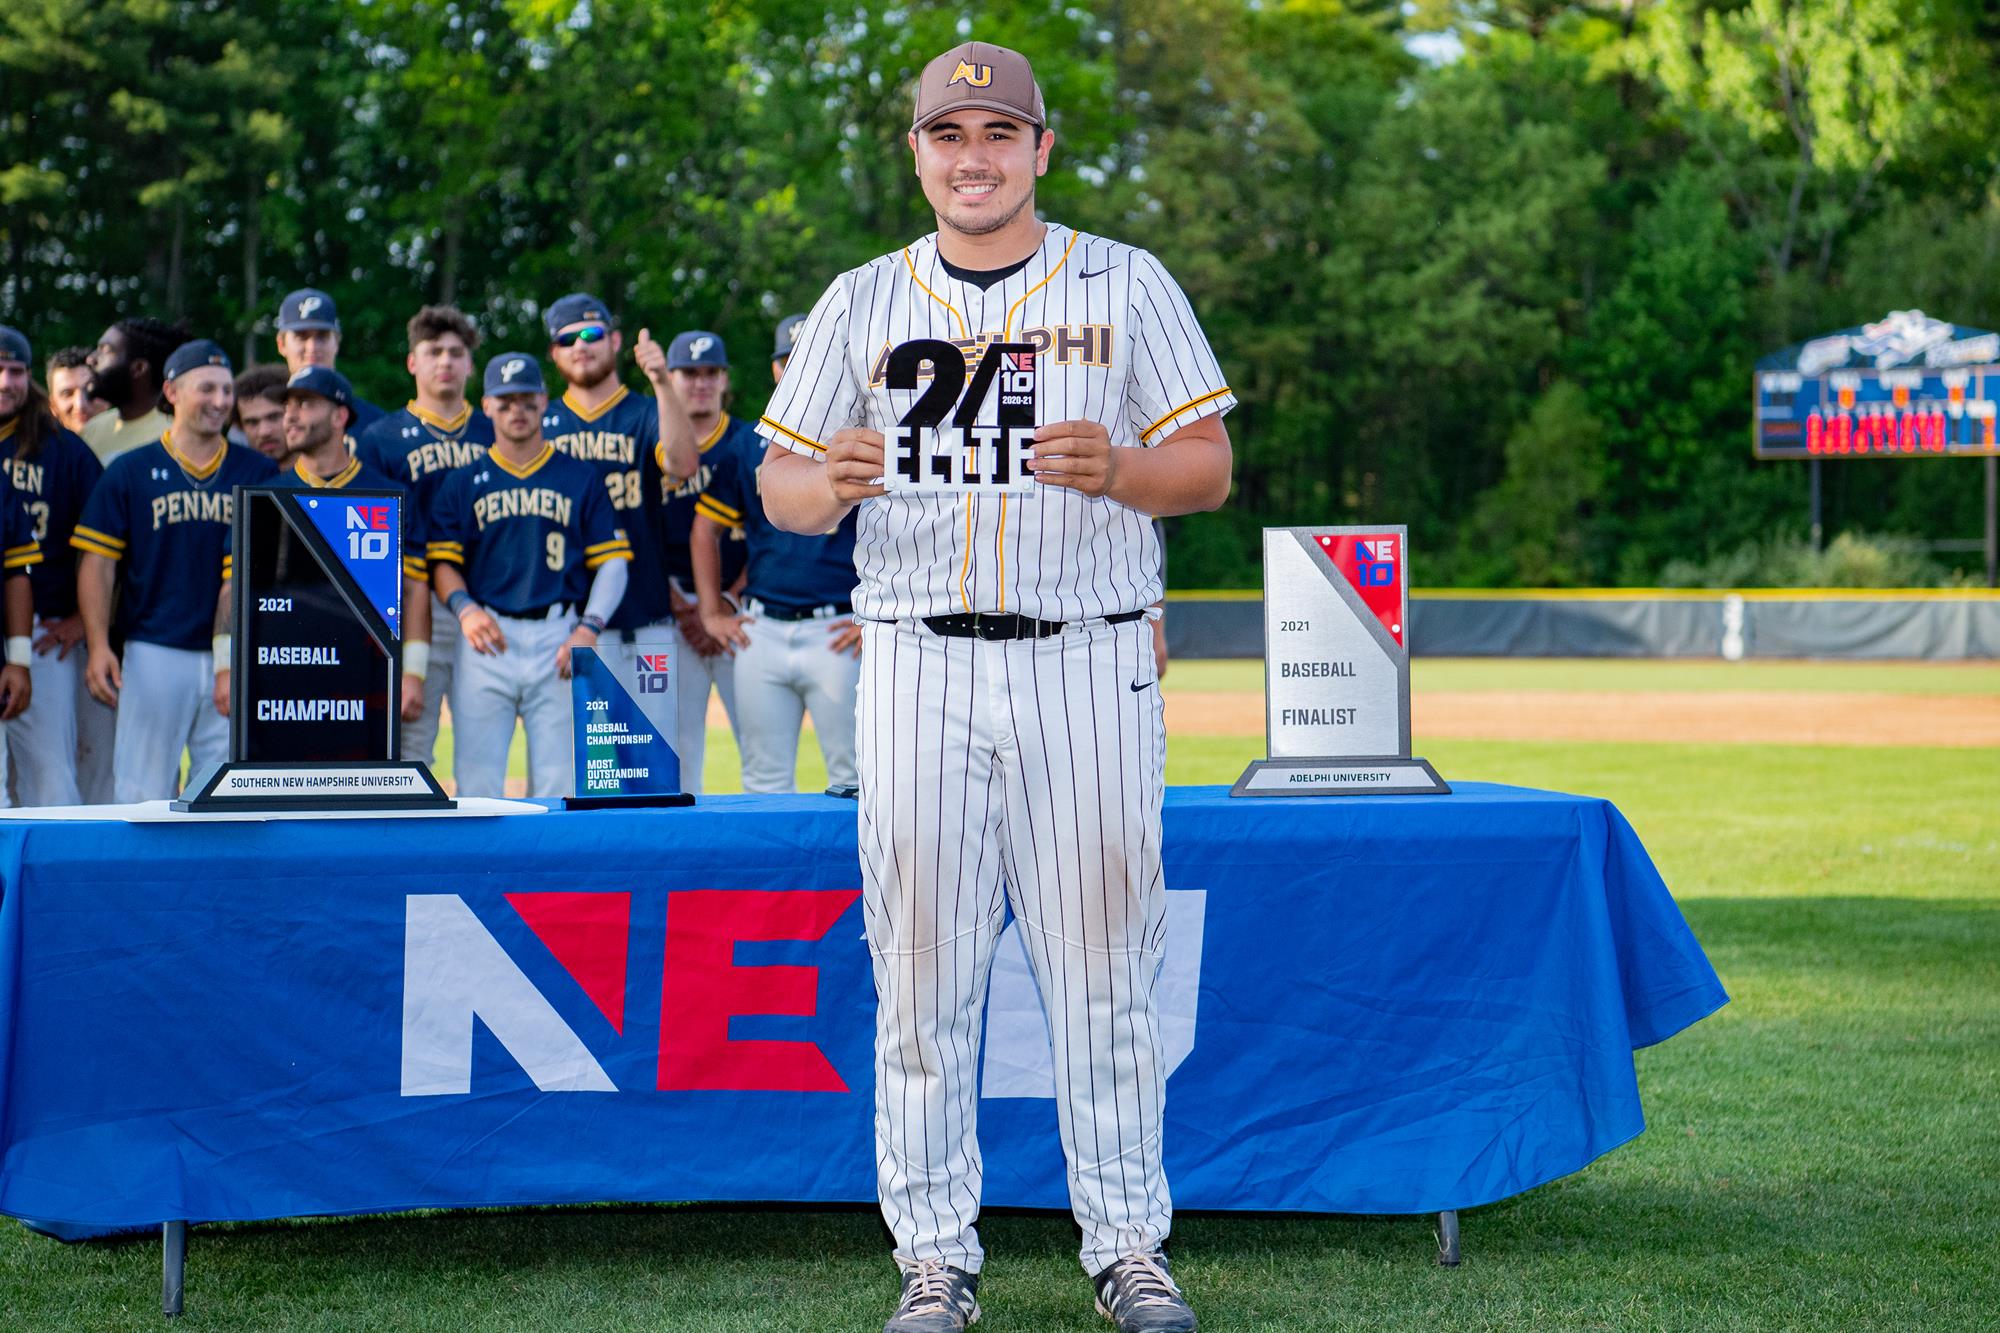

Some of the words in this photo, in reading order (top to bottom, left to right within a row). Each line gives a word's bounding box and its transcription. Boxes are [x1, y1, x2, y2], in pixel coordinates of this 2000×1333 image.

[946, 58, 993, 88] AU
[1000, 351, 1034, 371] NE
[1000, 371, 1034, 393] 10
[1002, 395, 1032, 405] 2020-21
[884, 426, 1035, 491] ELITE
[604, 469, 642, 511] 28
[152, 490, 233, 531] PENME
[347, 505, 391, 530] NE
[474, 487, 572, 532] PENMEN
[347, 531, 389, 560] 10
[546, 531, 565, 571] 9
[1356, 540, 1395, 561] NE
[1357, 563, 1394, 587] 10
[258, 598, 293, 612] 2021
[1280, 620, 1310, 632] 2021
[257, 646, 341, 666] BASEBALL
[636, 654, 670, 672] NE
[1281, 662, 1357, 678] BASEBALL
[636, 673, 669, 694] 10
[257, 699, 365, 722] CHAMPION
[586, 700, 609, 711] 2021
[1281, 708, 1357, 726] FINALIST
[586, 722, 629, 734] BASEBALL
[586, 734, 653, 746] CHAMPIONSHIP
[587, 759, 614, 770] MOST
[587, 767, 649, 780] OUTSTANDING
[231, 777, 280, 789] SOUTHERN
[282, 777, 304, 788] NEW
[306, 776, 359, 788] HAMPSHIRE
[361, 775, 414, 787] UNIVERSITY
[587, 778, 620, 790] PLAYER
[1289, 773, 1331, 783] ADELPHI
[1332, 772, 1391, 783] UNIVERSITY
